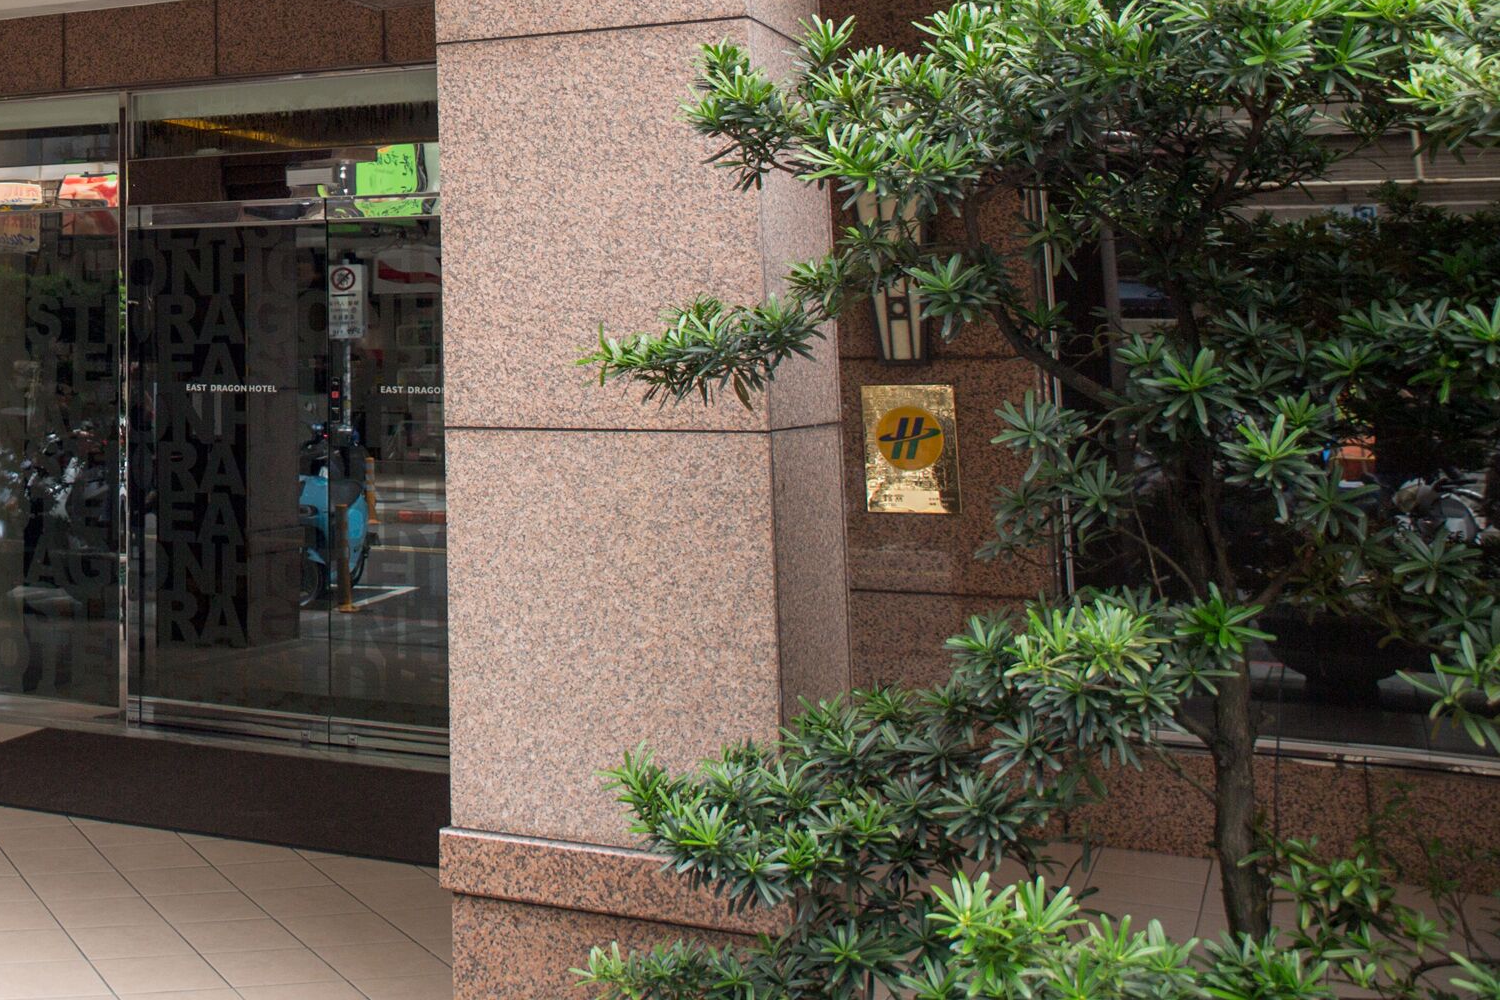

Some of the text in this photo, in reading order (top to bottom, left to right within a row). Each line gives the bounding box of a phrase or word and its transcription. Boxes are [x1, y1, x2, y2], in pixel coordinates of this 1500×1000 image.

[186, 383, 277, 393] EAST DRAGON HOTEL
[380, 385, 404, 394] EAST
